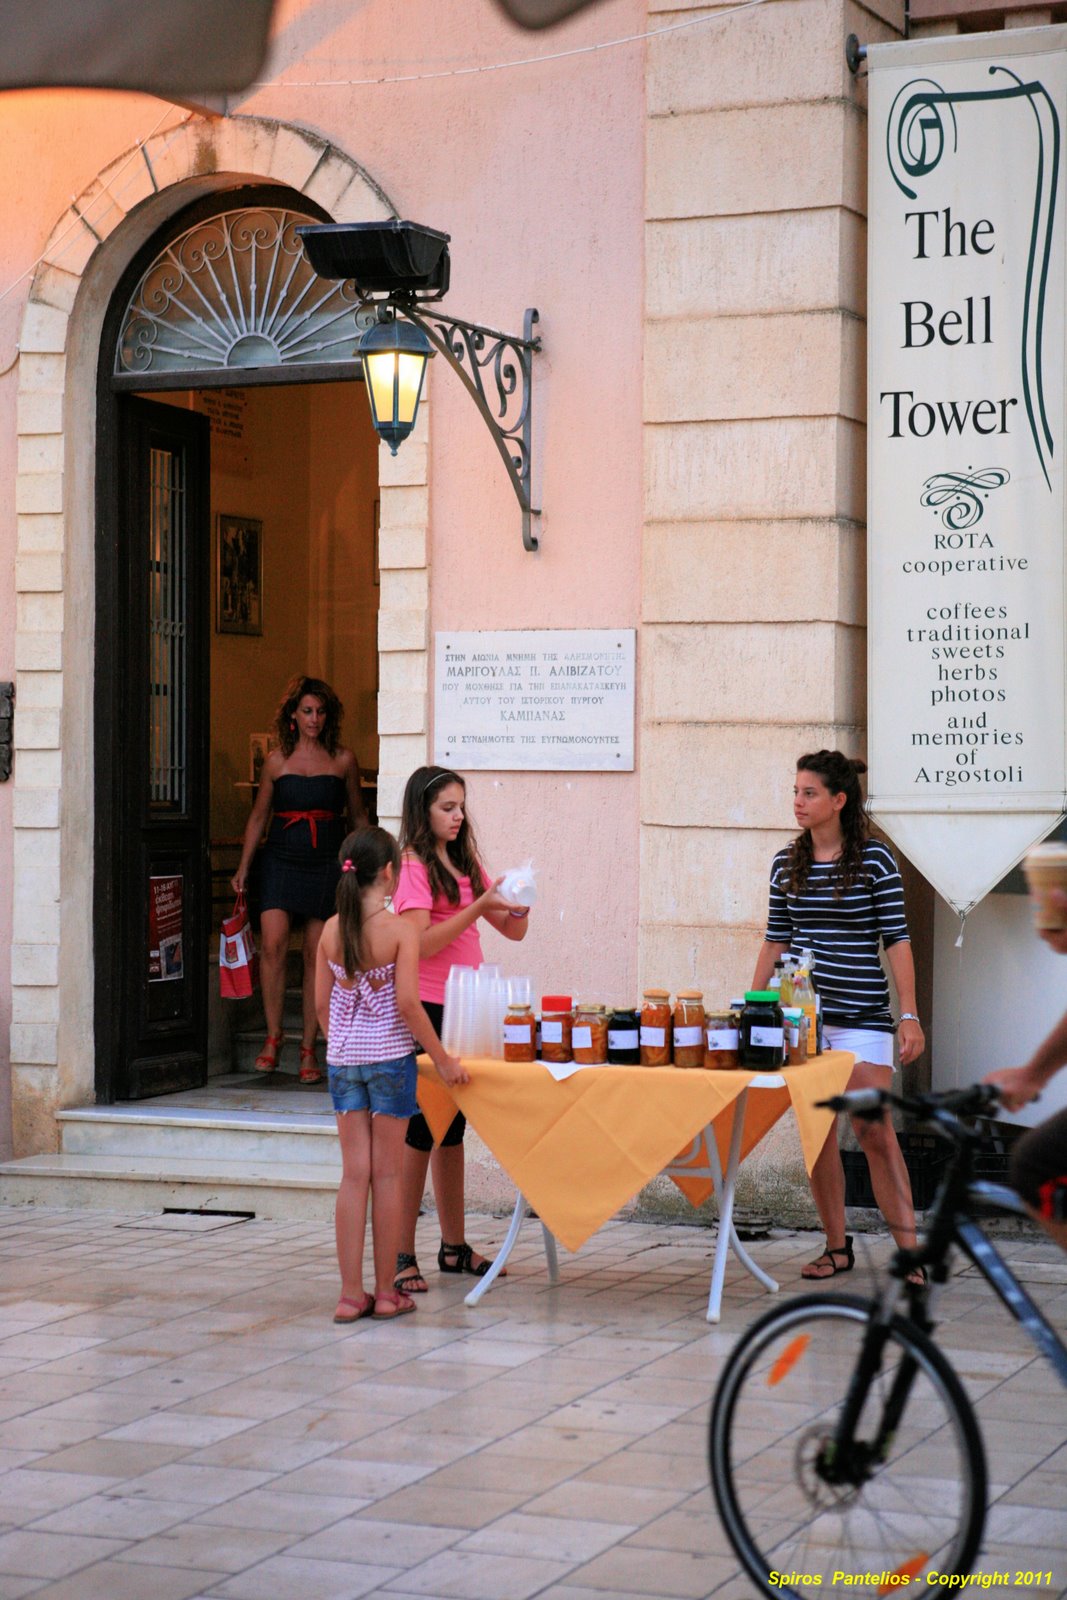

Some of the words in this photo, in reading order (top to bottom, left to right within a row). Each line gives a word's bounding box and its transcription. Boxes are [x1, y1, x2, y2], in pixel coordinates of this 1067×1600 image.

[904, 207, 996, 259] The
[900, 295, 994, 348] Bell
[880, 391, 1018, 438] Tower
[934, 533, 994, 549] ROTA
[902, 555, 1029, 576] cooperative
[926, 602, 1008, 620] coffees
[907, 622, 1030, 642] traditional
[445, 653, 466, 662] ΣΤΗΝ
[471, 653, 499, 661] ΑΙΩΝΙΑ
[506, 653, 536, 661] ΜΝΗΜΗ
[542, 653, 558, 661] ΤΗΣ
[931, 644, 1005, 660] sweets
[446, 666, 521, 677] ΜΑΡΙΓΟΥΛΑΣ
[530, 666, 541, 677] Π.
[549, 665, 622, 676] ΑΛΙΒΙΖΑΤΟΥ
[938, 664, 998, 681] herbs
[442, 683, 459, 691] ΠΟΥ
[510, 683, 523, 691] ΓΙΑ
[931, 685, 1006, 706] photos
[463, 697, 492, 705] ΑΥΤΟΥ
[498, 697, 515, 705] ΤΟΥ
[571, 696, 604, 704] ΠΥΡΓΟΥ
[500, 710, 566, 721] ΚΑΜΠΑΝΑΣ
[541, 736, 620, 744] ΕΥΓΝΩΜΟΝΟΥΝΤΕΣ
[911, 729, 1024, 746] memories
[955, 748, 978, 766] of
[914, 765, 1024, 787] Argostoli
